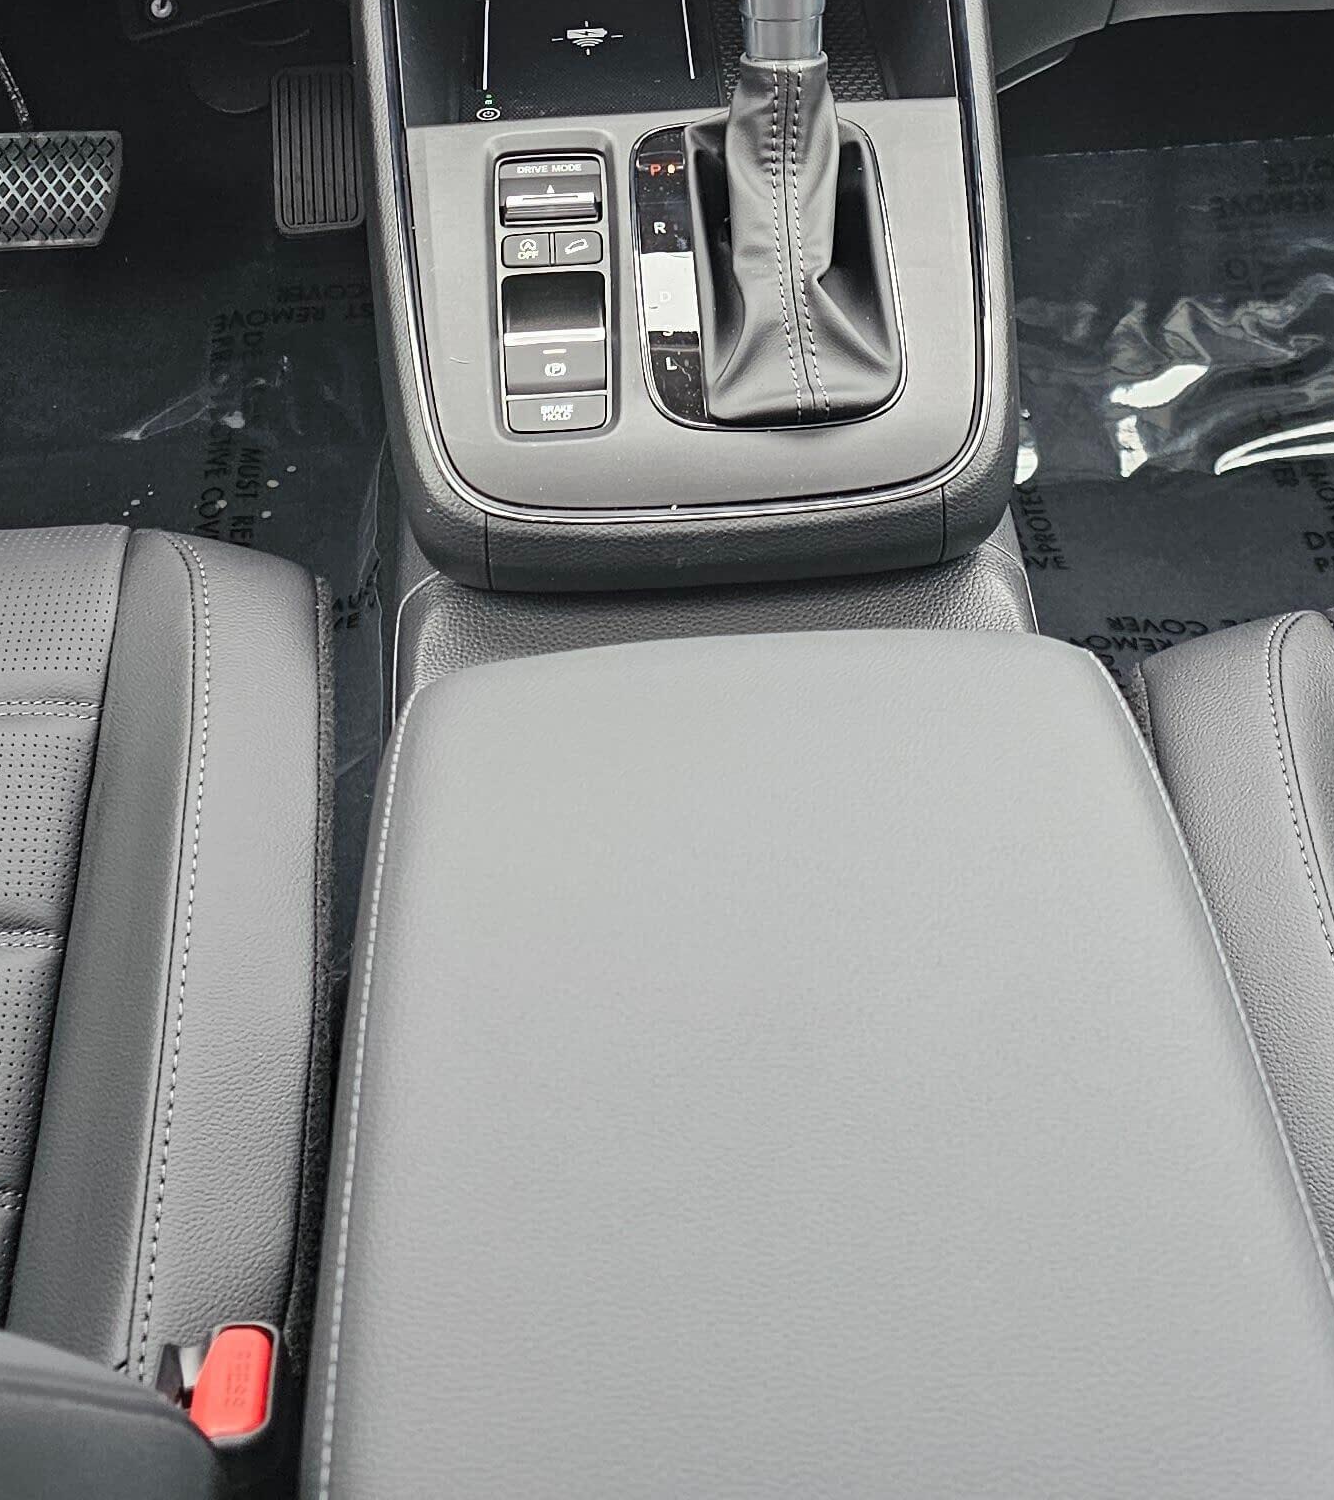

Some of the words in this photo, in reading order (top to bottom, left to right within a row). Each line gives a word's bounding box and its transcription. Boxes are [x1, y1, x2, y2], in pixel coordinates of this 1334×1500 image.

[517, 165, 548, 174] DRIVE
[551, 164, 582, 173] MODE
[650, 164, 661, 176] P
[654, 222, 666, 234] R
[518, 250, 539, 259] OFF
[660, 292, 672, 303] D
[666, 357, 677, 370] L
[540, 404, 574, 414] BRAKE
[542, 412, 572, 421] HOLD
[234, 448, 262, 499] MUST
[1106, 616, 1209, 636] COVER
